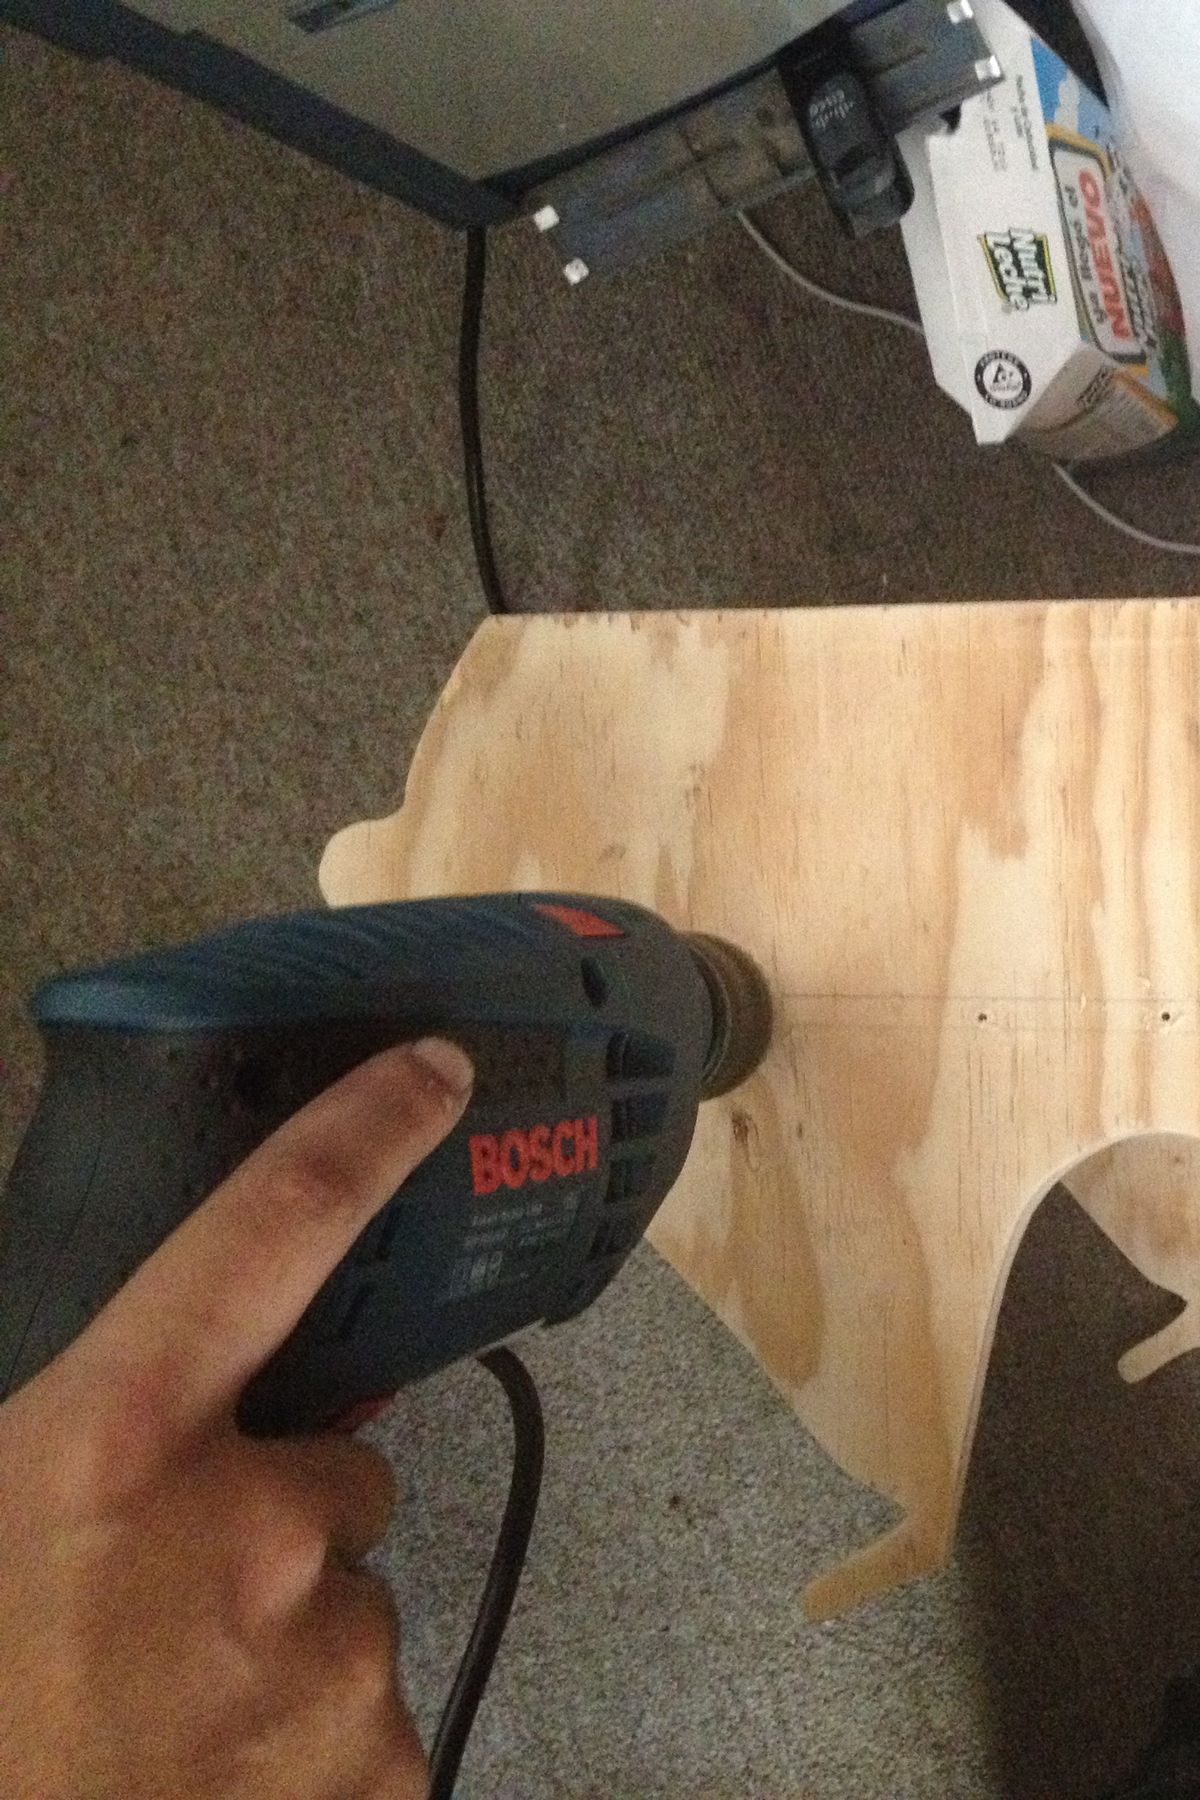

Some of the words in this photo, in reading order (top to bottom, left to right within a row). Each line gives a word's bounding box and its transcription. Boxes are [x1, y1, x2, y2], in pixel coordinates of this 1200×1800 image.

[984, 233, 1029, 310] Leche
[1009, 228, 1057, 303] Nutri
[1078, 168, 1133, 341] NUEVO
[468, 1116, 598, 1196] BOSCH
